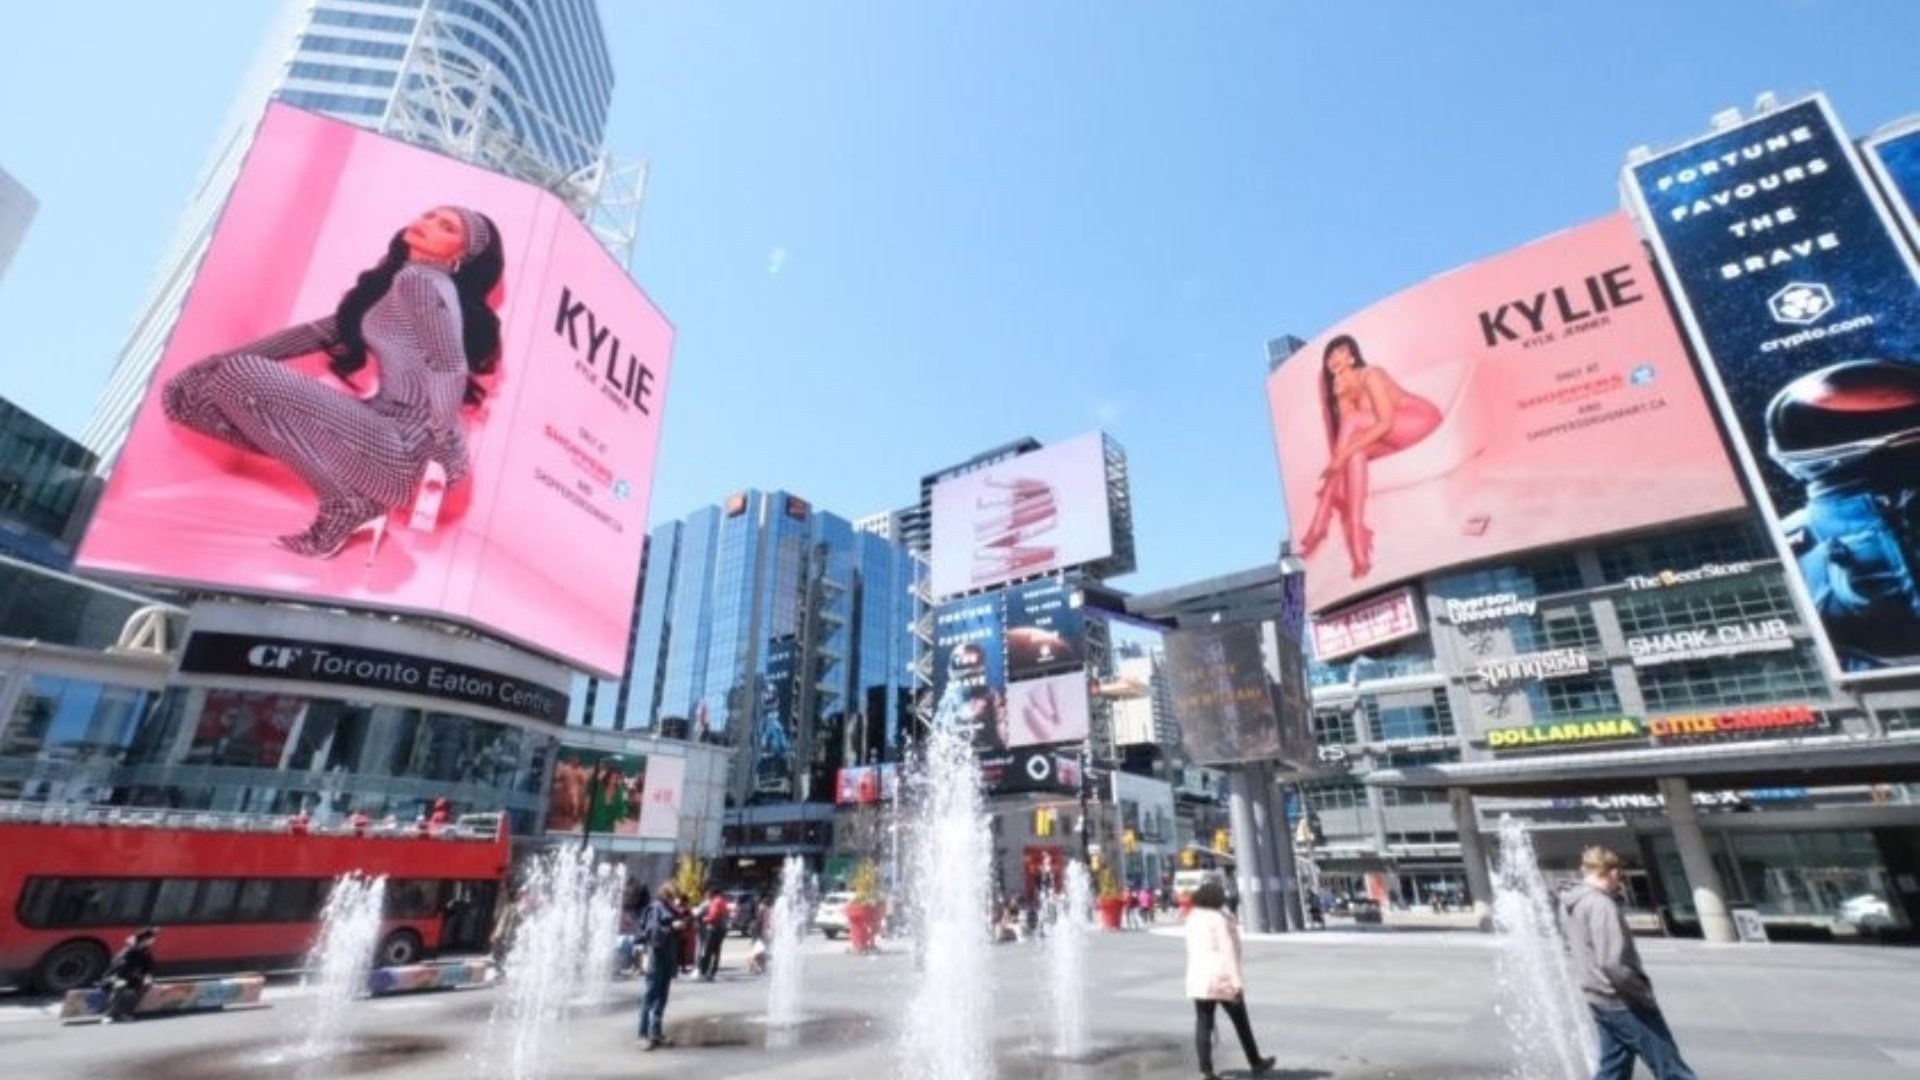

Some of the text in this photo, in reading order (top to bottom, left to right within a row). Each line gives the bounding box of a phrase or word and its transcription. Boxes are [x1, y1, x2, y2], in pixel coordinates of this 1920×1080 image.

[1657, 126, 1812, 191] FORTUNE
[1671, 158, 1828, 222] FAVOURS
[1729, 206, 1797, 238] THE
[1720, 232, 1840, 280] BRAVE
[1478, 264, 1644, 348] KYLIE
[554, 285, 654, 416] KYLIE
[1522, 316, 1610, 349] KYLIE JENNER
[1760, 314, 1874, 353] crypto.com
[1449, 600, 1538, 624] University
[1628, 618, 1788, 657] SHARK CLUB
[249, 645, 553, 713] CF Toronto Eaton Centre
[1488, 718, 1636, 746] DOLLARAMA
